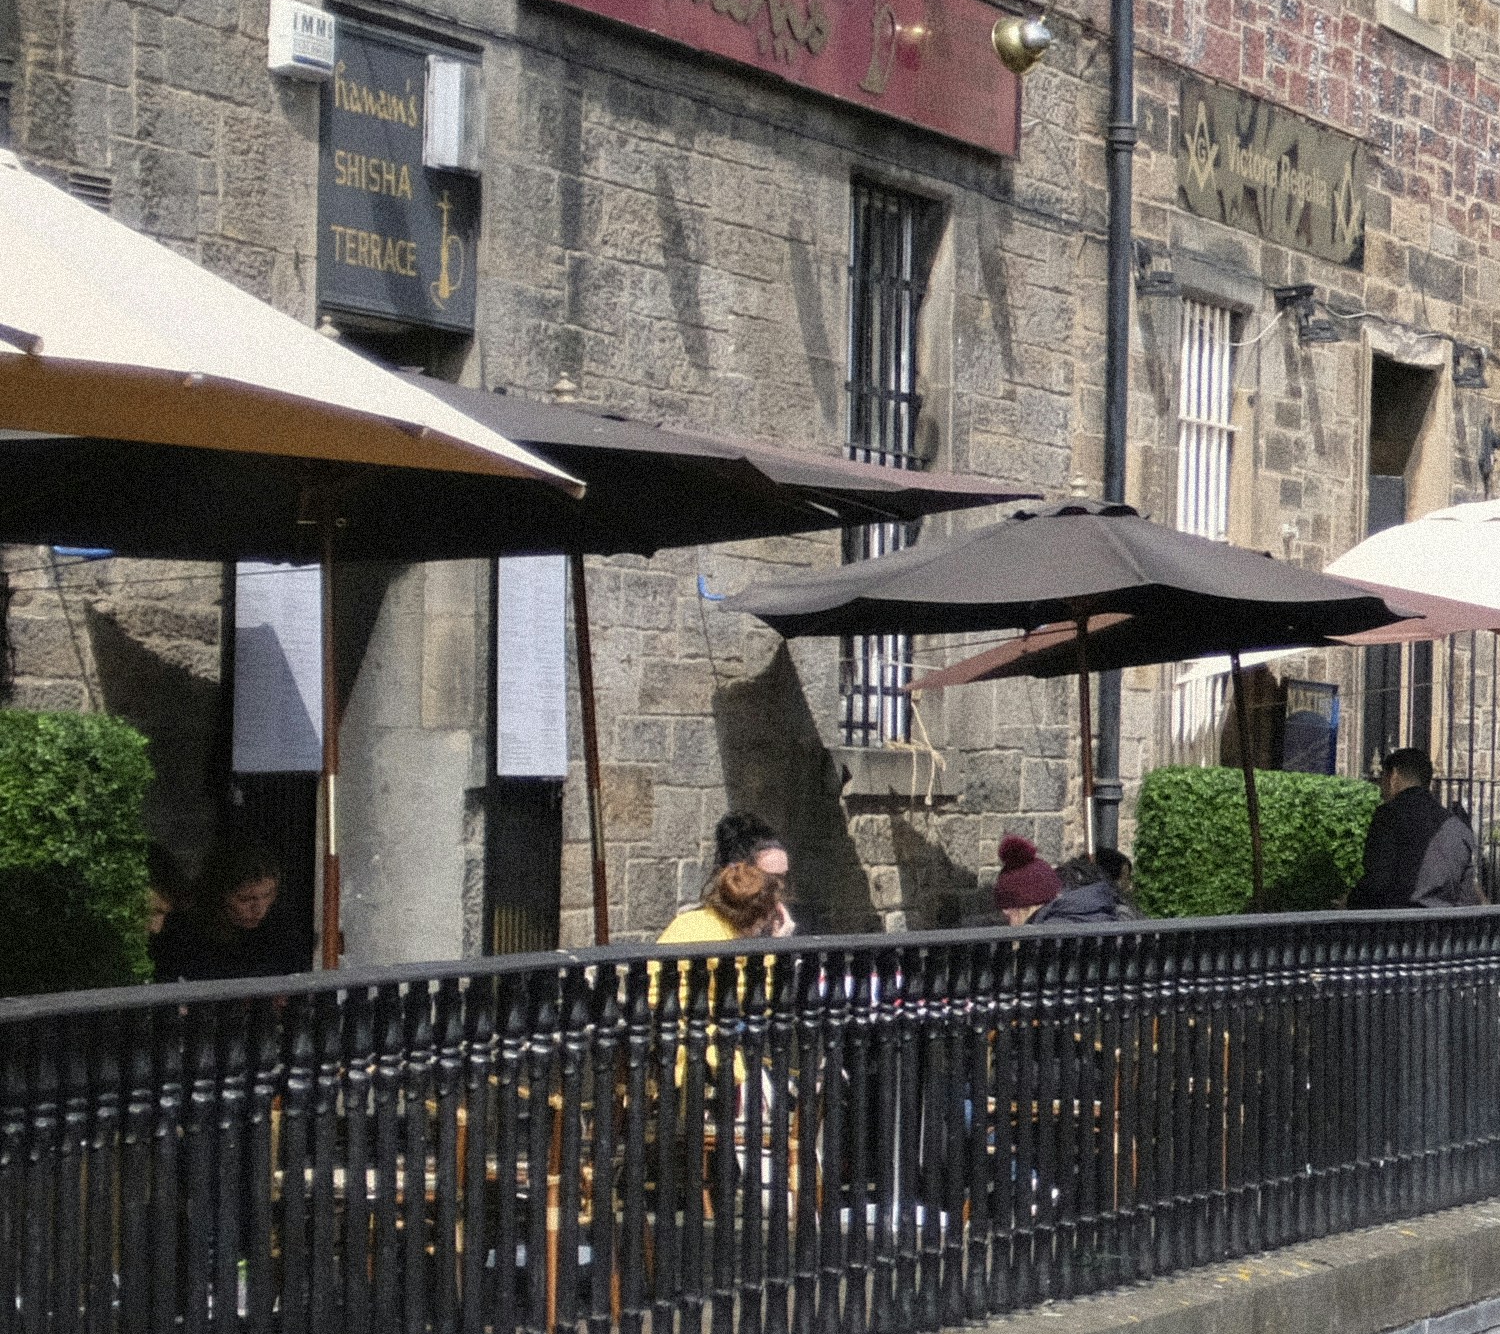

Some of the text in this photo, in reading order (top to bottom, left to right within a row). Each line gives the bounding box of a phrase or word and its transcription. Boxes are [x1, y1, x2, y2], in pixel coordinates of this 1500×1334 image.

[334, 150, 413, 200] SHISHA
[1226, 135, 1328, 208] Victoria Regalia
[331, 225, 418, 277] TERRACE
